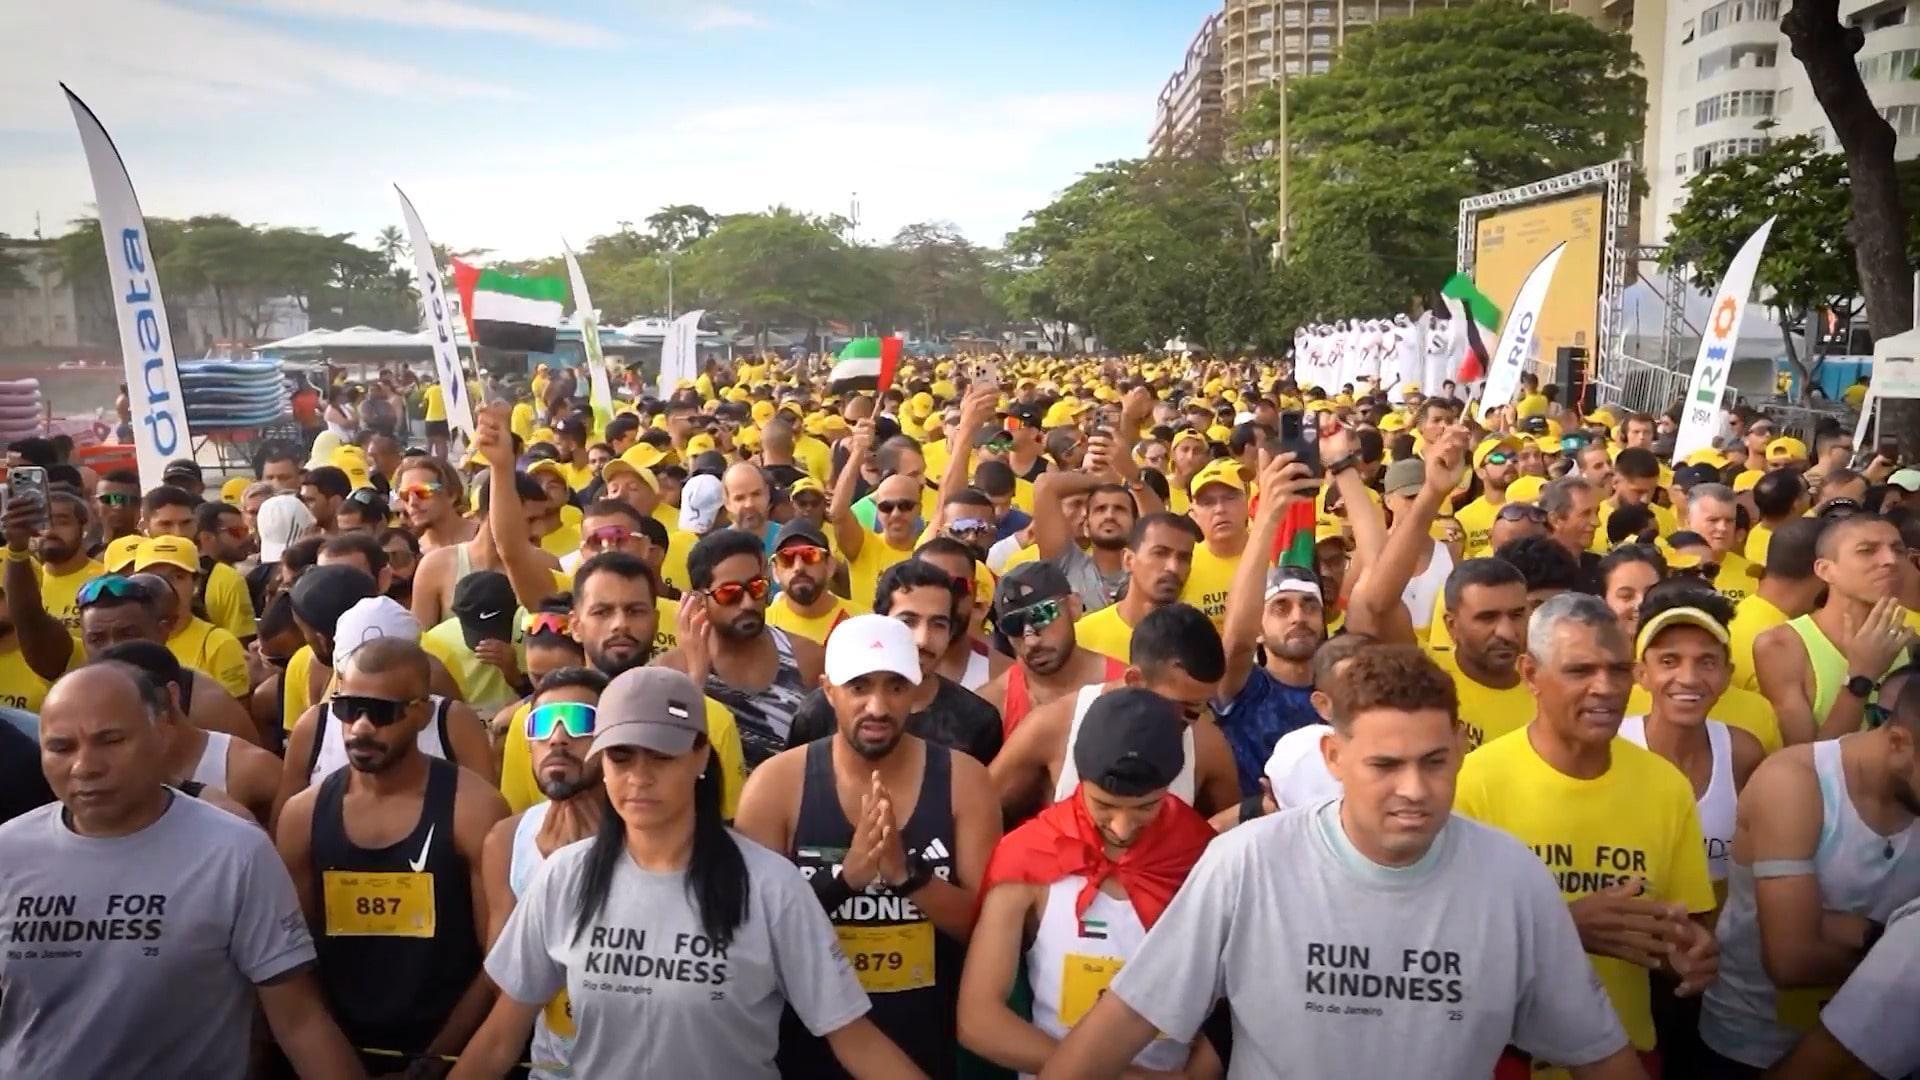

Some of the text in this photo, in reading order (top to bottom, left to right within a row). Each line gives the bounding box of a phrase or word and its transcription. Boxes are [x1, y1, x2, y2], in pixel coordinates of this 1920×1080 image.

[122, 228, 177, 456] dnata
[1507, 311, 1533, 366] RIO
[1595, 846, 1646, 872] FOR
[16, 894, 167, 918] RUN FOR
[356, 897, 401, 915] 887
[11, 919, 162, 943] KINDNESS
[590, 926, 729, 960] RUN FOR
[585, 951, 728, 985] KINDNESS
[855, 951, 903, 972] 879
[1307, 942, 1462, 976] RUN FOR
[1306, 970, 1463, 1004] KINDNESS
